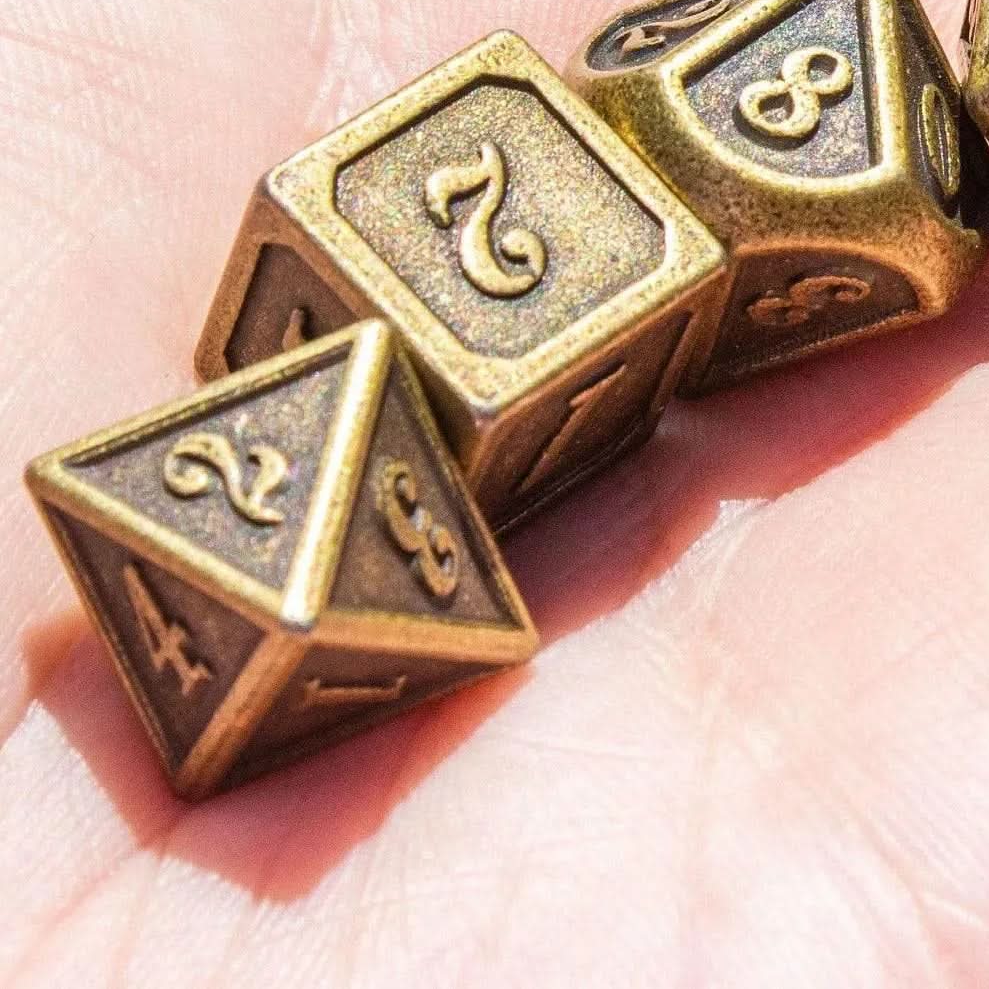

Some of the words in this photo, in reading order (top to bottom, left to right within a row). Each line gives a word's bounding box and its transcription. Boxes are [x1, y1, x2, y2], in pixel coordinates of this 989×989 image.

[739, 45, 854, 138] 8
[162, 431, 289, 525] 2
[123, 563, 212, 697] 4
[302, 674, 407, 708] 1
